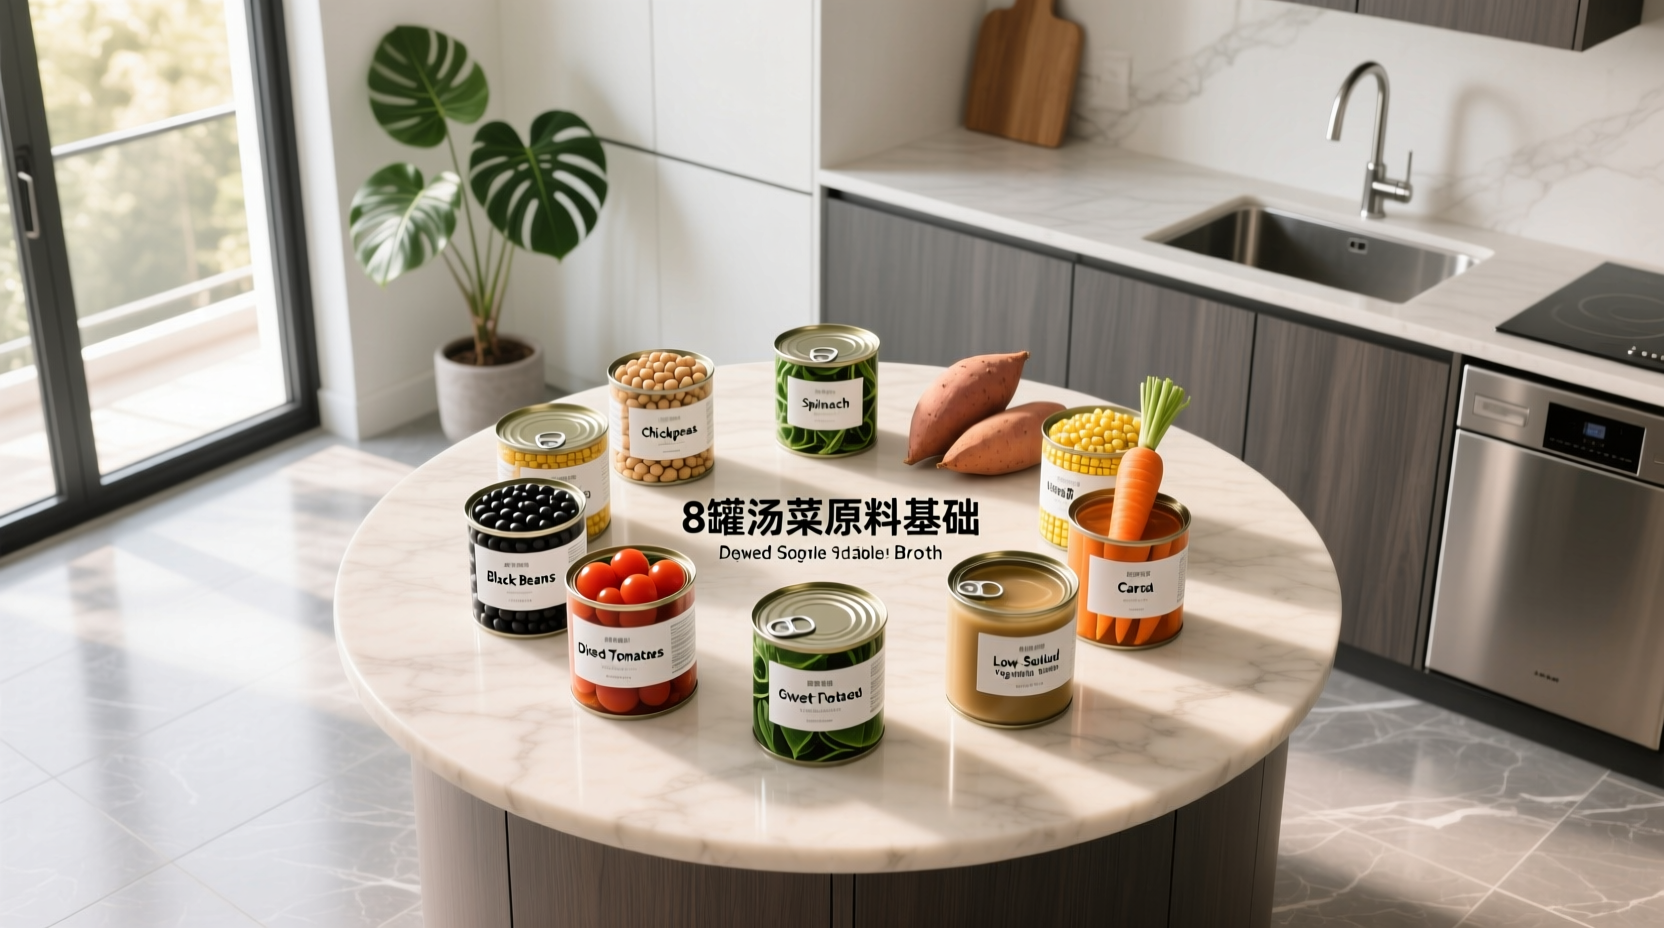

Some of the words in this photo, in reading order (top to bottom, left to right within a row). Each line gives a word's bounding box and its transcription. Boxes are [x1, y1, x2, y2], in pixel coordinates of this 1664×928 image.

[487, 569, 517, 587] Black
[519, 573, 556, 586] Beans
[993, 655, 1018, 669] Low
